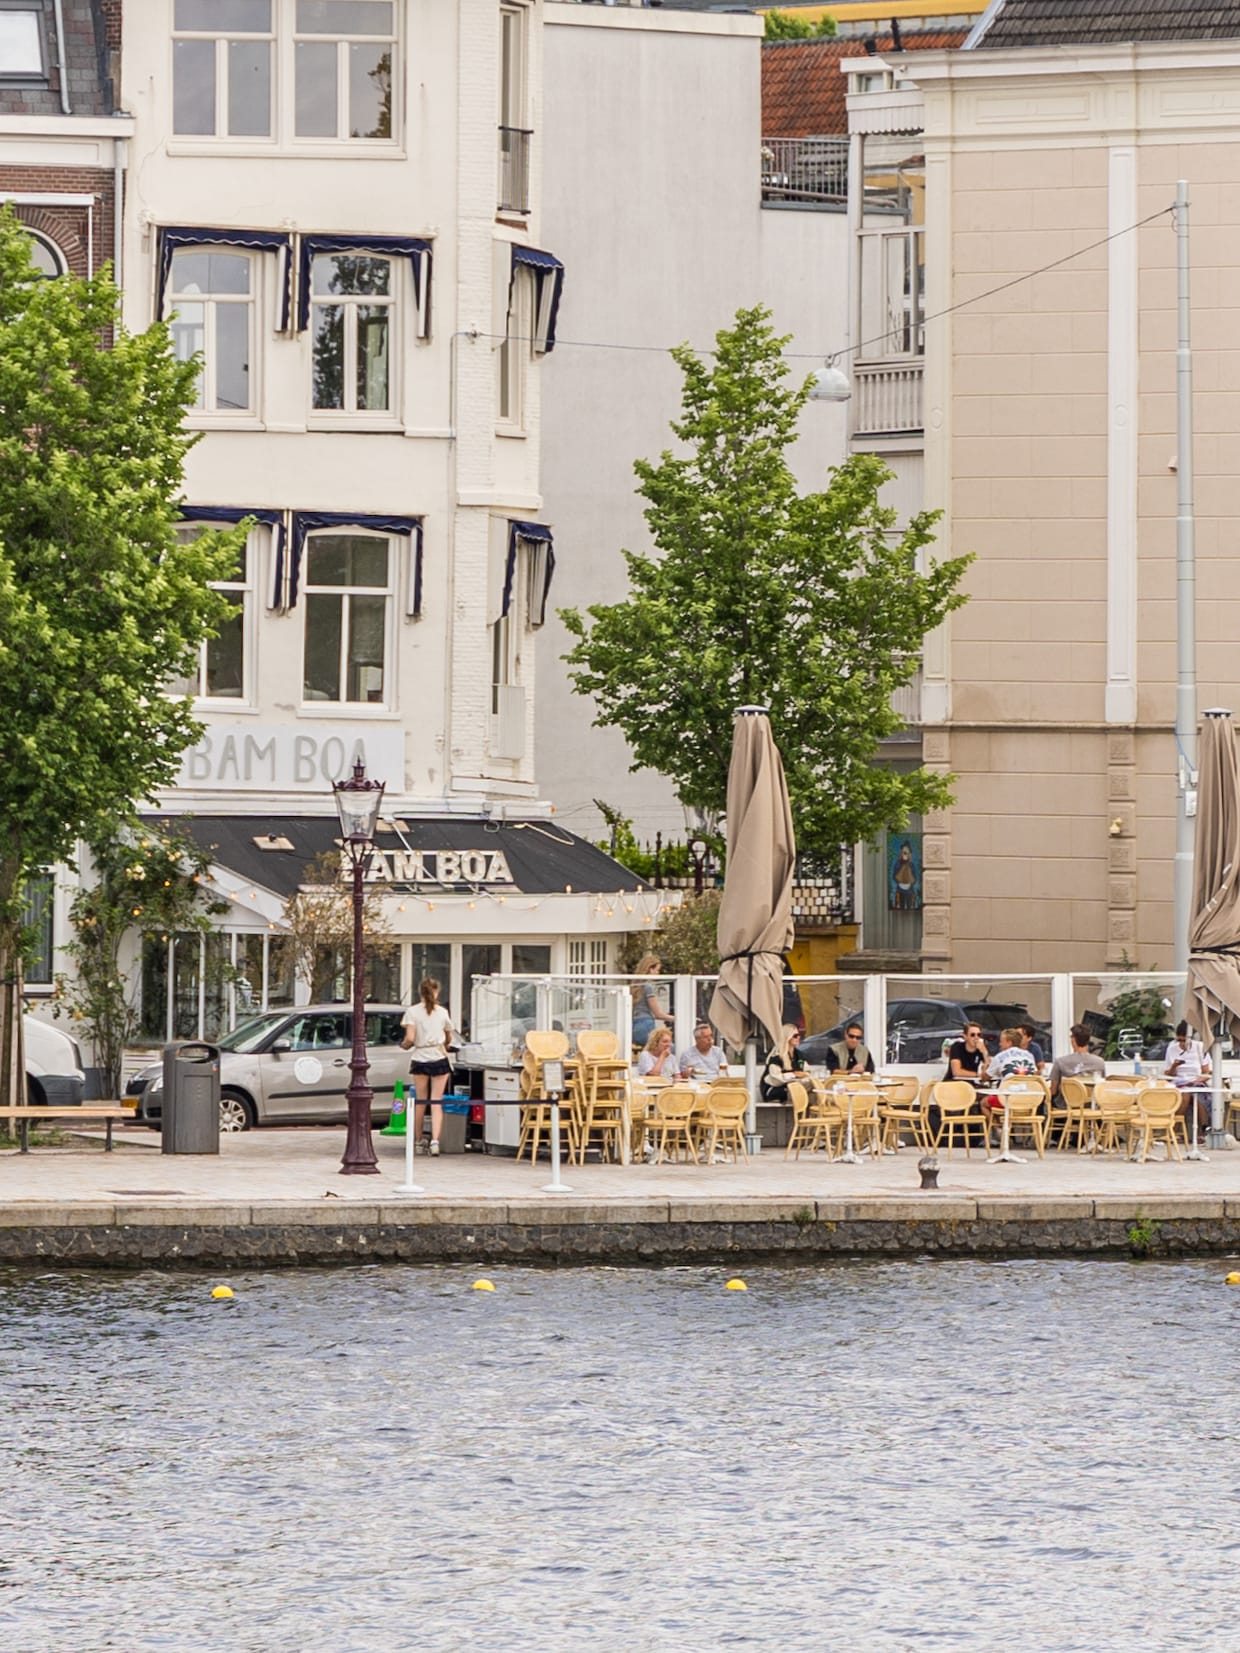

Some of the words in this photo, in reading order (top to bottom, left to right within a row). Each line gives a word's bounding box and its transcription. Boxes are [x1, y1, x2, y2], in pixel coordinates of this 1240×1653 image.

[189, 734, 276, 782] BAM
[294, 735, 367, 783] BOA
[436, 850, 514, 882] BOA
